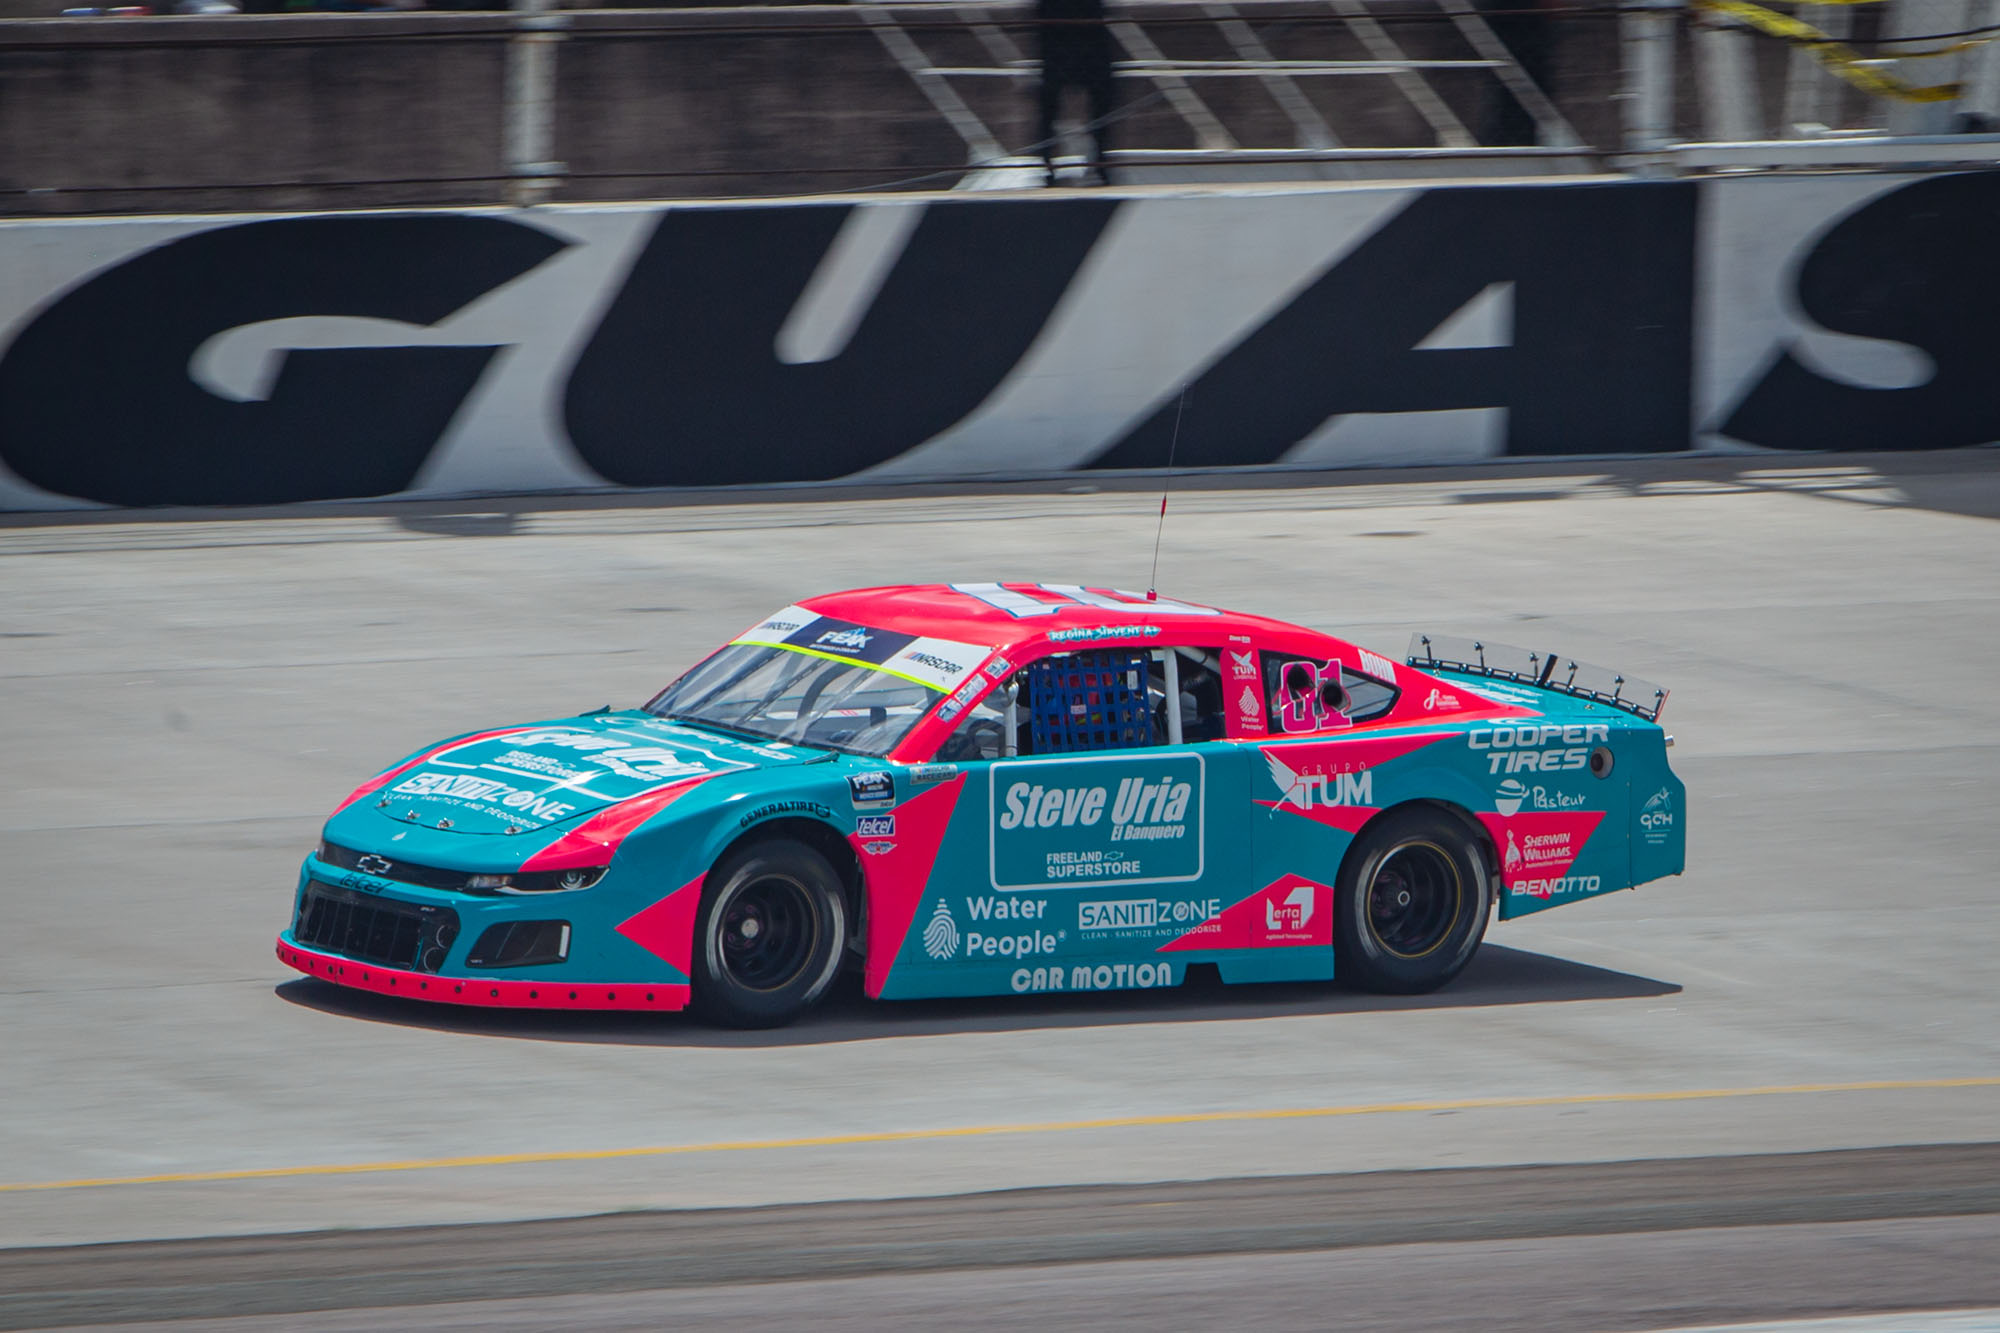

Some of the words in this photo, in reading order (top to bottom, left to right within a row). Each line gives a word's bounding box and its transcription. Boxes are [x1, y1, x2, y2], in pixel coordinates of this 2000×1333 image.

[816, 630, 874, 649] PEAK
[914, 652, 963, 675] NASCAR
[1467, 724, 1610, 750] COOPER
[1302, 761, 1367, 775] GRUPO
[1486, 747, 1589, 775] TIRES
[852, 772, 890, 789] PEAK
[1297, 771, 1373, 810] TUM
[392, 772, 577, 821] SANITIZONE
[1000, 782, 1107, 829] Steve
[1111, 776, 1192, 825] Uria
[1532, 786, 1586, 808] Pasteur
[858, 818, 893, 835] telcel
[1111, 825, 1124, 841] El
[1124, 825, 1185, 841] Banquero
[1524, 832, 1571, 848] SHERWIN
[1046, 851, 1103, 865] FREELAND
[1523, 847, 1571, 861] WILLIAMS
[1046, 861, 1140, 878] SUPERSTORE
[339, 873, 394, 894] telcel
[1511, 875, 1601, 896] BENOTTO
[966, 896, 1048, 921] Water
[1078, 898, 1222, 930] SANITIZONE
[1081, 931, 1107, 940] CLEAN
[1115, 929, 1151, 938] SANITIZE
[1155, 928, 1172, 937] AND
[1174, 924, 1222, 936] DEODORIZE
[1011, 968, 1063, 992] CAR
[1071, 963, 1171, 990] MOTION
